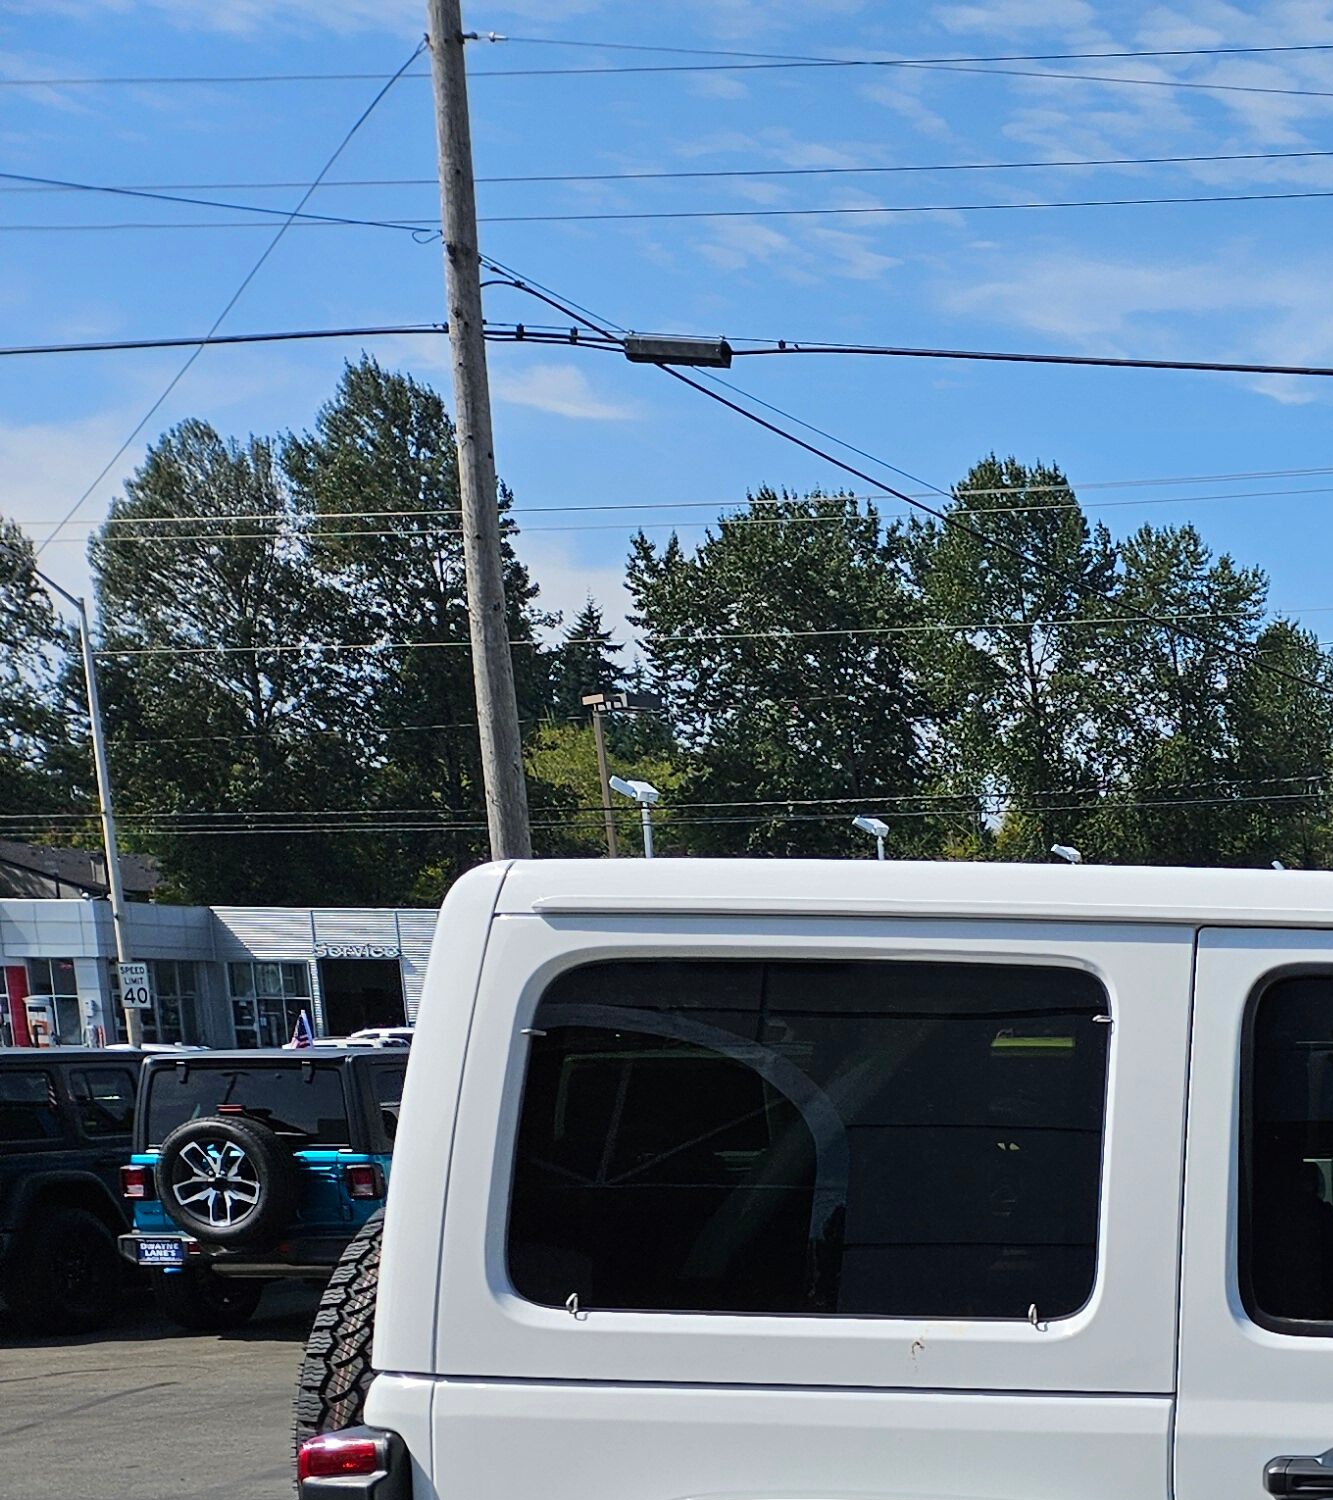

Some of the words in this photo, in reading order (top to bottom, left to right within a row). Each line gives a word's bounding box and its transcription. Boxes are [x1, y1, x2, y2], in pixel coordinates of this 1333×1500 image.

[313, 941, 400, 958] Service
[119, 966, 145, 975] SPEED
[124, 977, 144, 985] LIMIT
[124, 987, 148, 1004] 40
[144, 1249, 177, 1257] LANE'S
